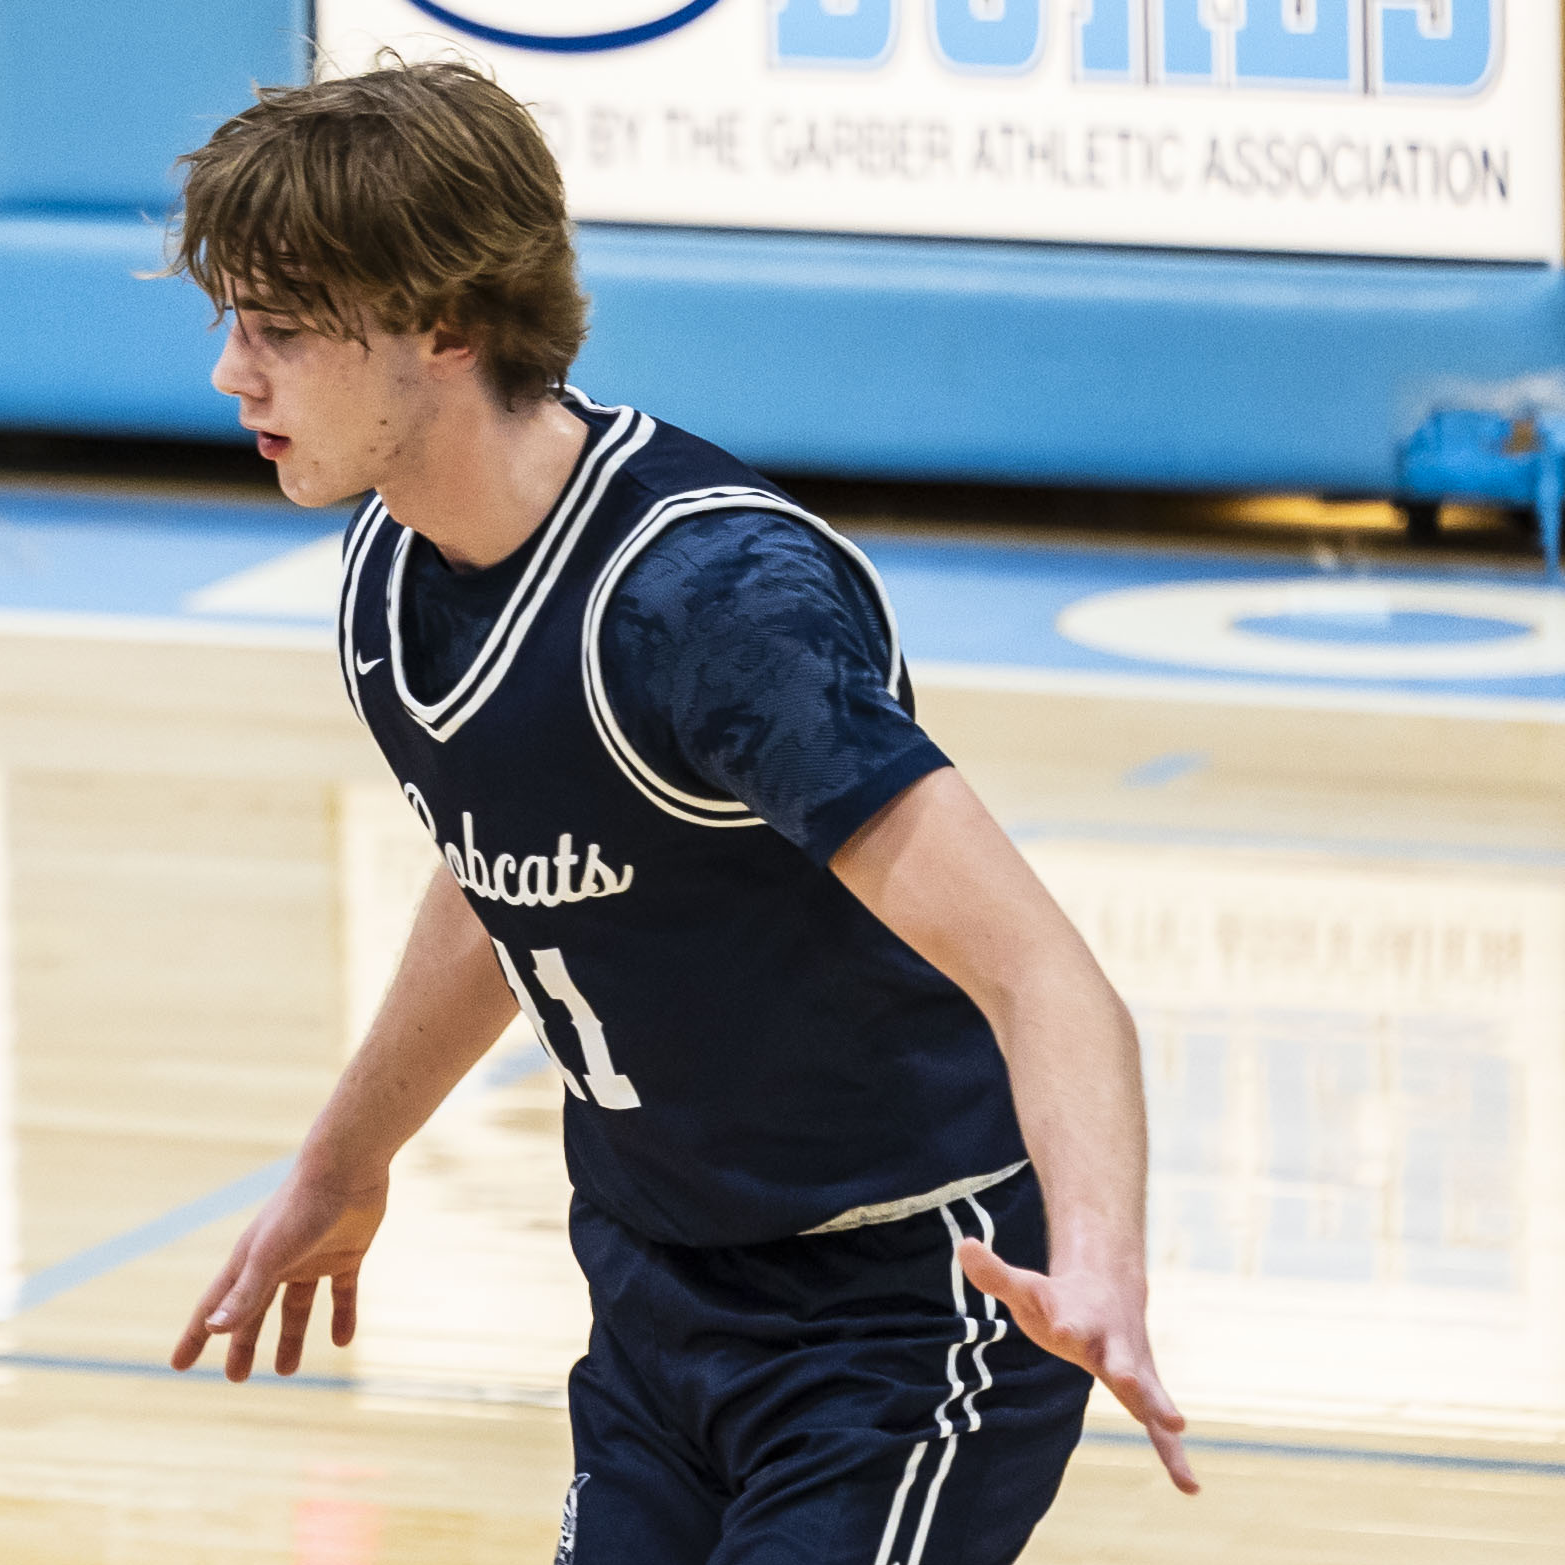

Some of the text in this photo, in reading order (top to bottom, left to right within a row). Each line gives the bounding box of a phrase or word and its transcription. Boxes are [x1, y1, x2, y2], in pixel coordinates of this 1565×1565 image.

[586, 104, 644, 172] BY
[664, 107, 747, 177] THE
[766, 111, 955, 182] GARBER
[972, 123, 1185, 191] ATHLETIC
[1203, 134, 1511, 207] ASSOCIATION
